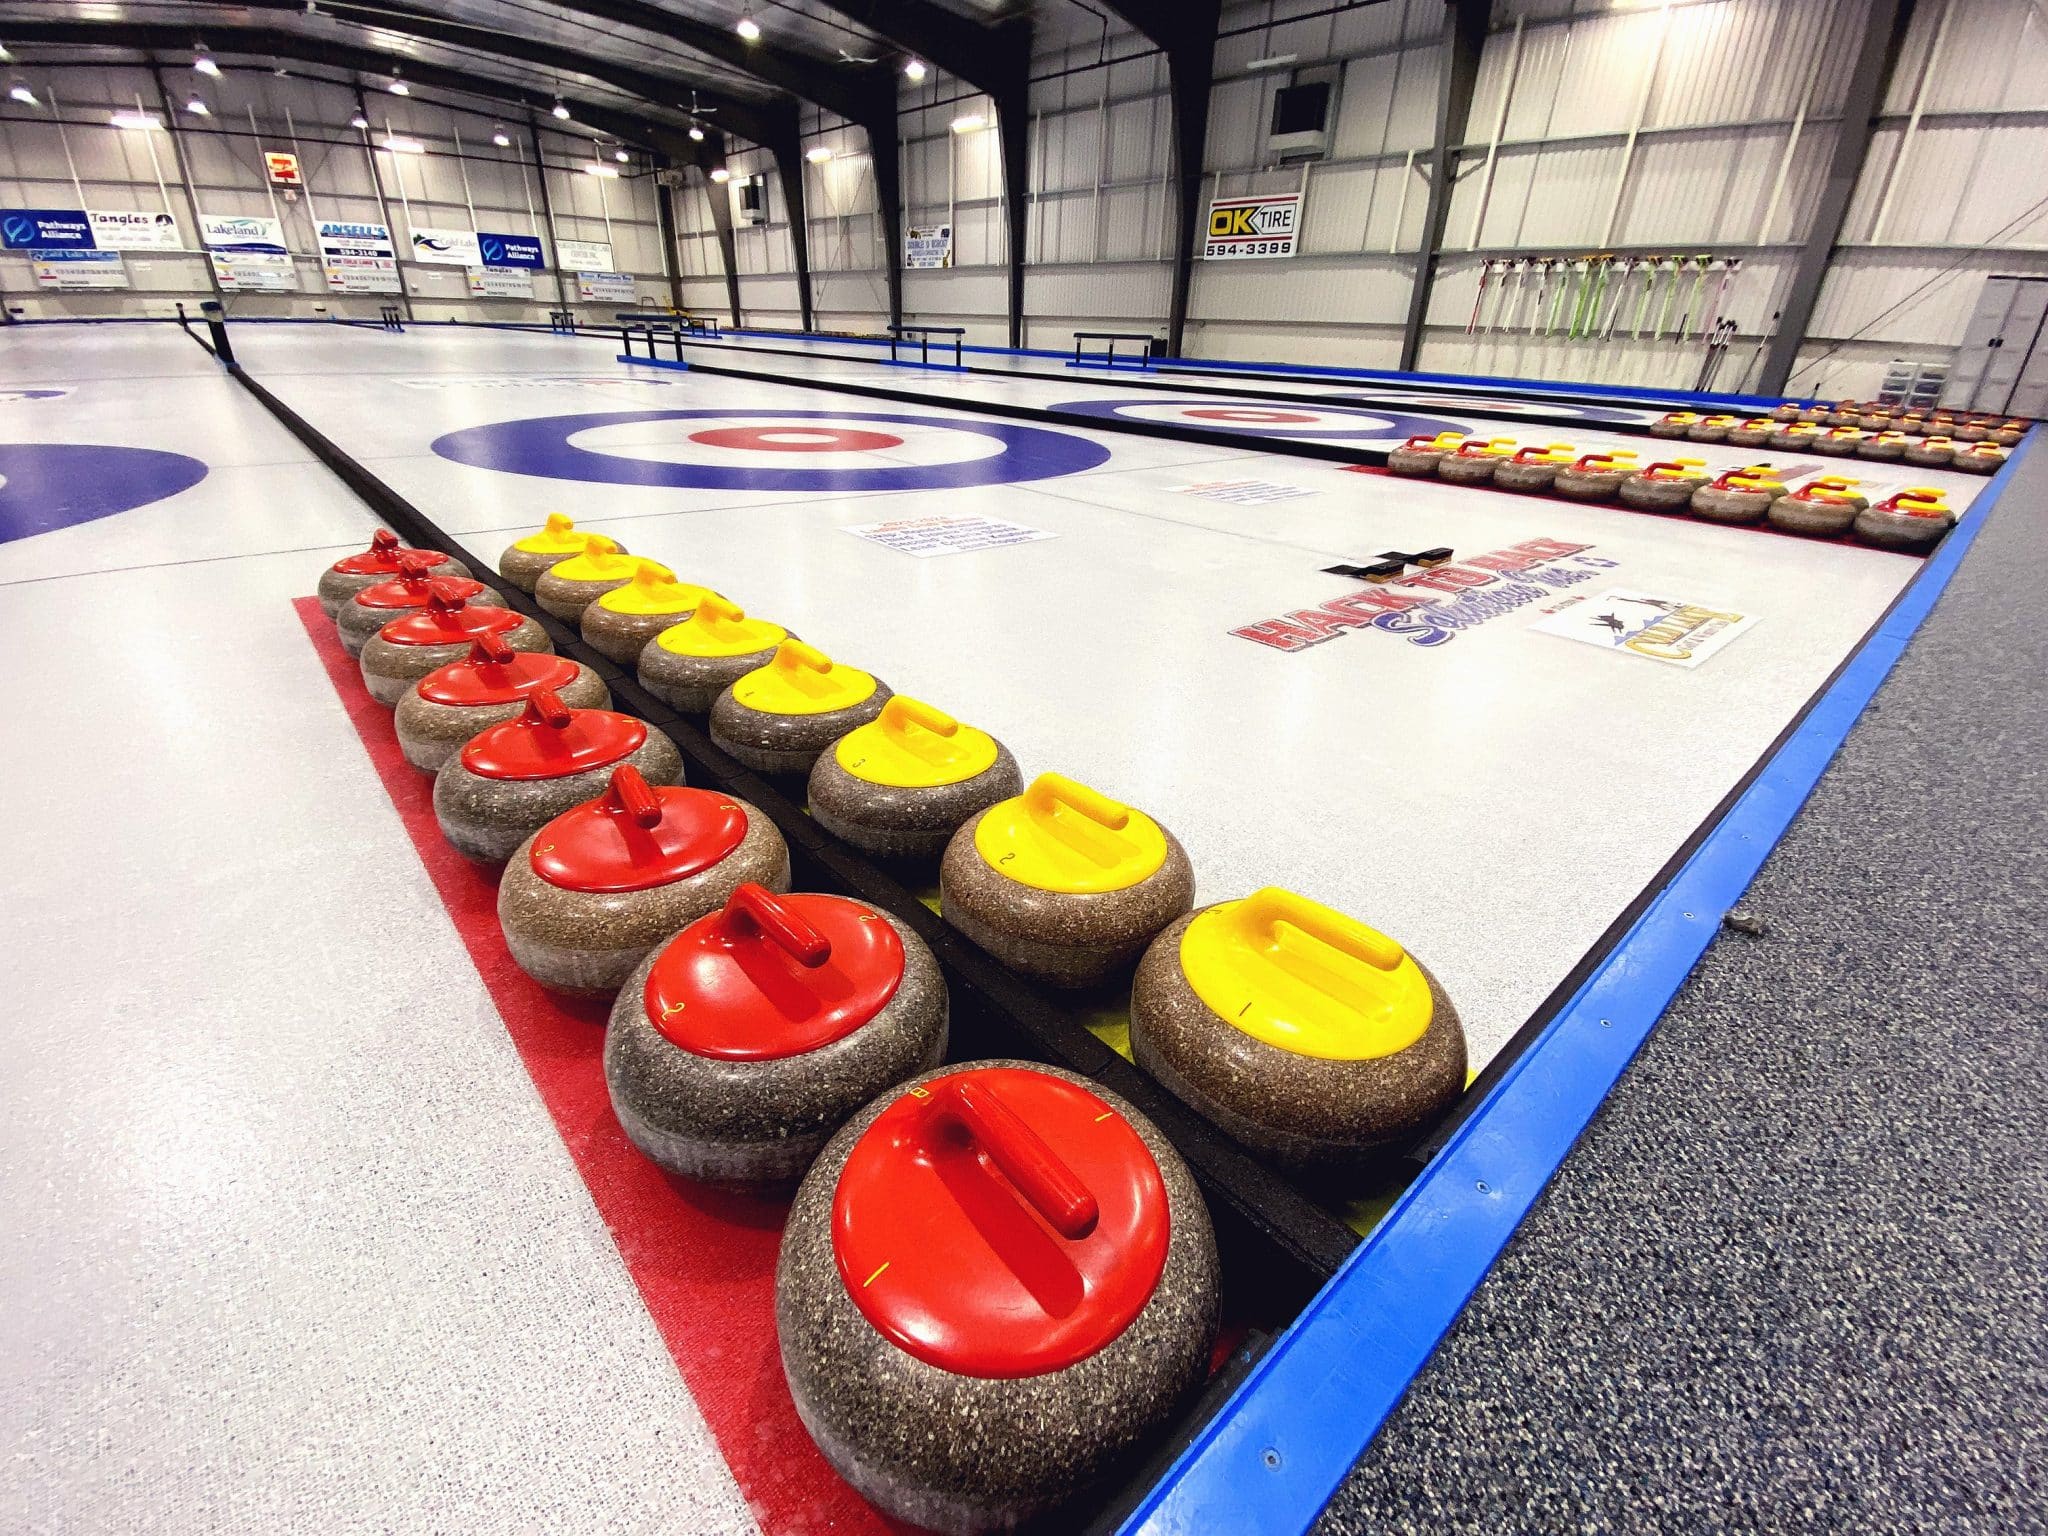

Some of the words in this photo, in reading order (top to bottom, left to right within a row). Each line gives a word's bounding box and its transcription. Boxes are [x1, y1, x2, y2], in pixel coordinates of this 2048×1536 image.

[38, 220, 87, 232] Pathways
[91, 212, 149, 226] Tangles
[1210, 208, 1255, 235] OK
[1261, 210, 1292, 228] TIRE
[41, 230, 83, 240] Alliance
[206, 221, 259, 237] Lakeland
[321, 224, 387, 238] ANSELL'S
[504, 243, 540, 253] Pathways
[1206, 242, 1291, 256] 594-3399
[507, 252, 536, 260] Alliance
[1227, 587, 1439, 653] HACK
[1392, 565, 1500, 596] TO
